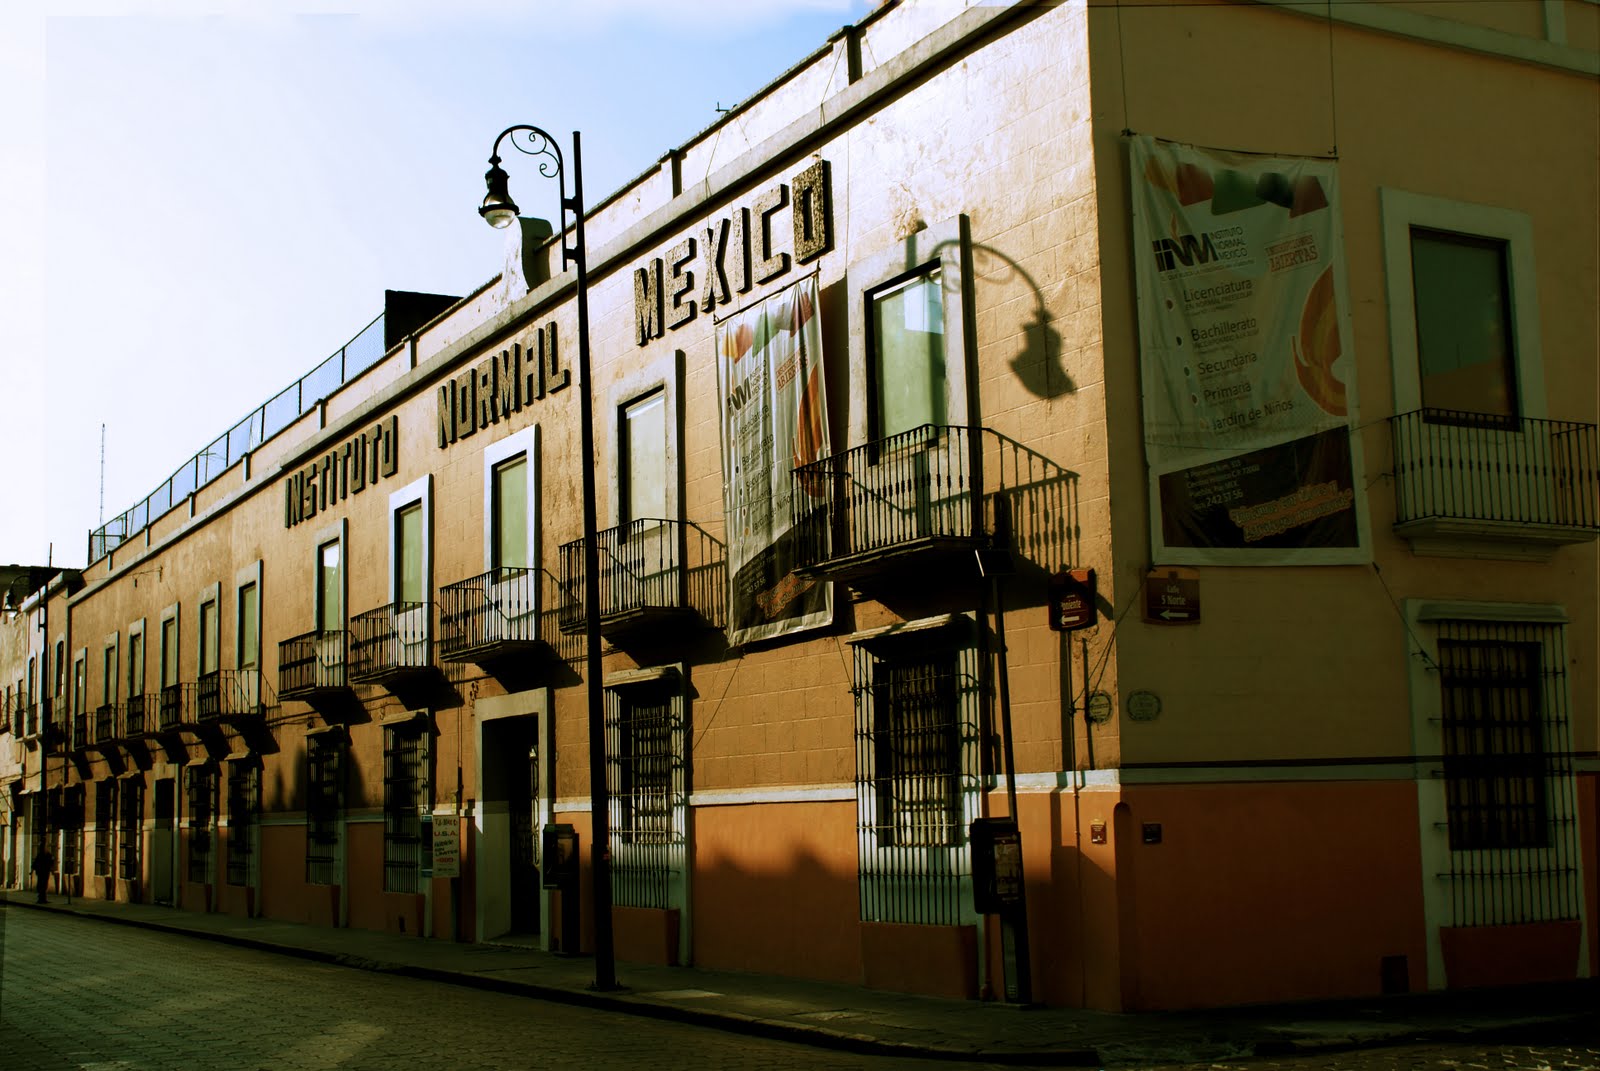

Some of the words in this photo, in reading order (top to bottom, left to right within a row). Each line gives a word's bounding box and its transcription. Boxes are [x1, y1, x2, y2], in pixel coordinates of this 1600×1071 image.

[1184, 279, 1253, 303] Licenciatura
[1192, 317, 1257, 342] Bachillerato
[284, 413, 399, 529] INSTITUTO
[437, 321, 571, 449] NORMAL
[634, 159, 835, 347] MEXICO
[1198, 352, 1258, 375] Secundaria
[1203, 382, 1252, 401] Primaria
[1248, 408, 1263, 421] de
[1263, 400, 1294, 417] Niños
